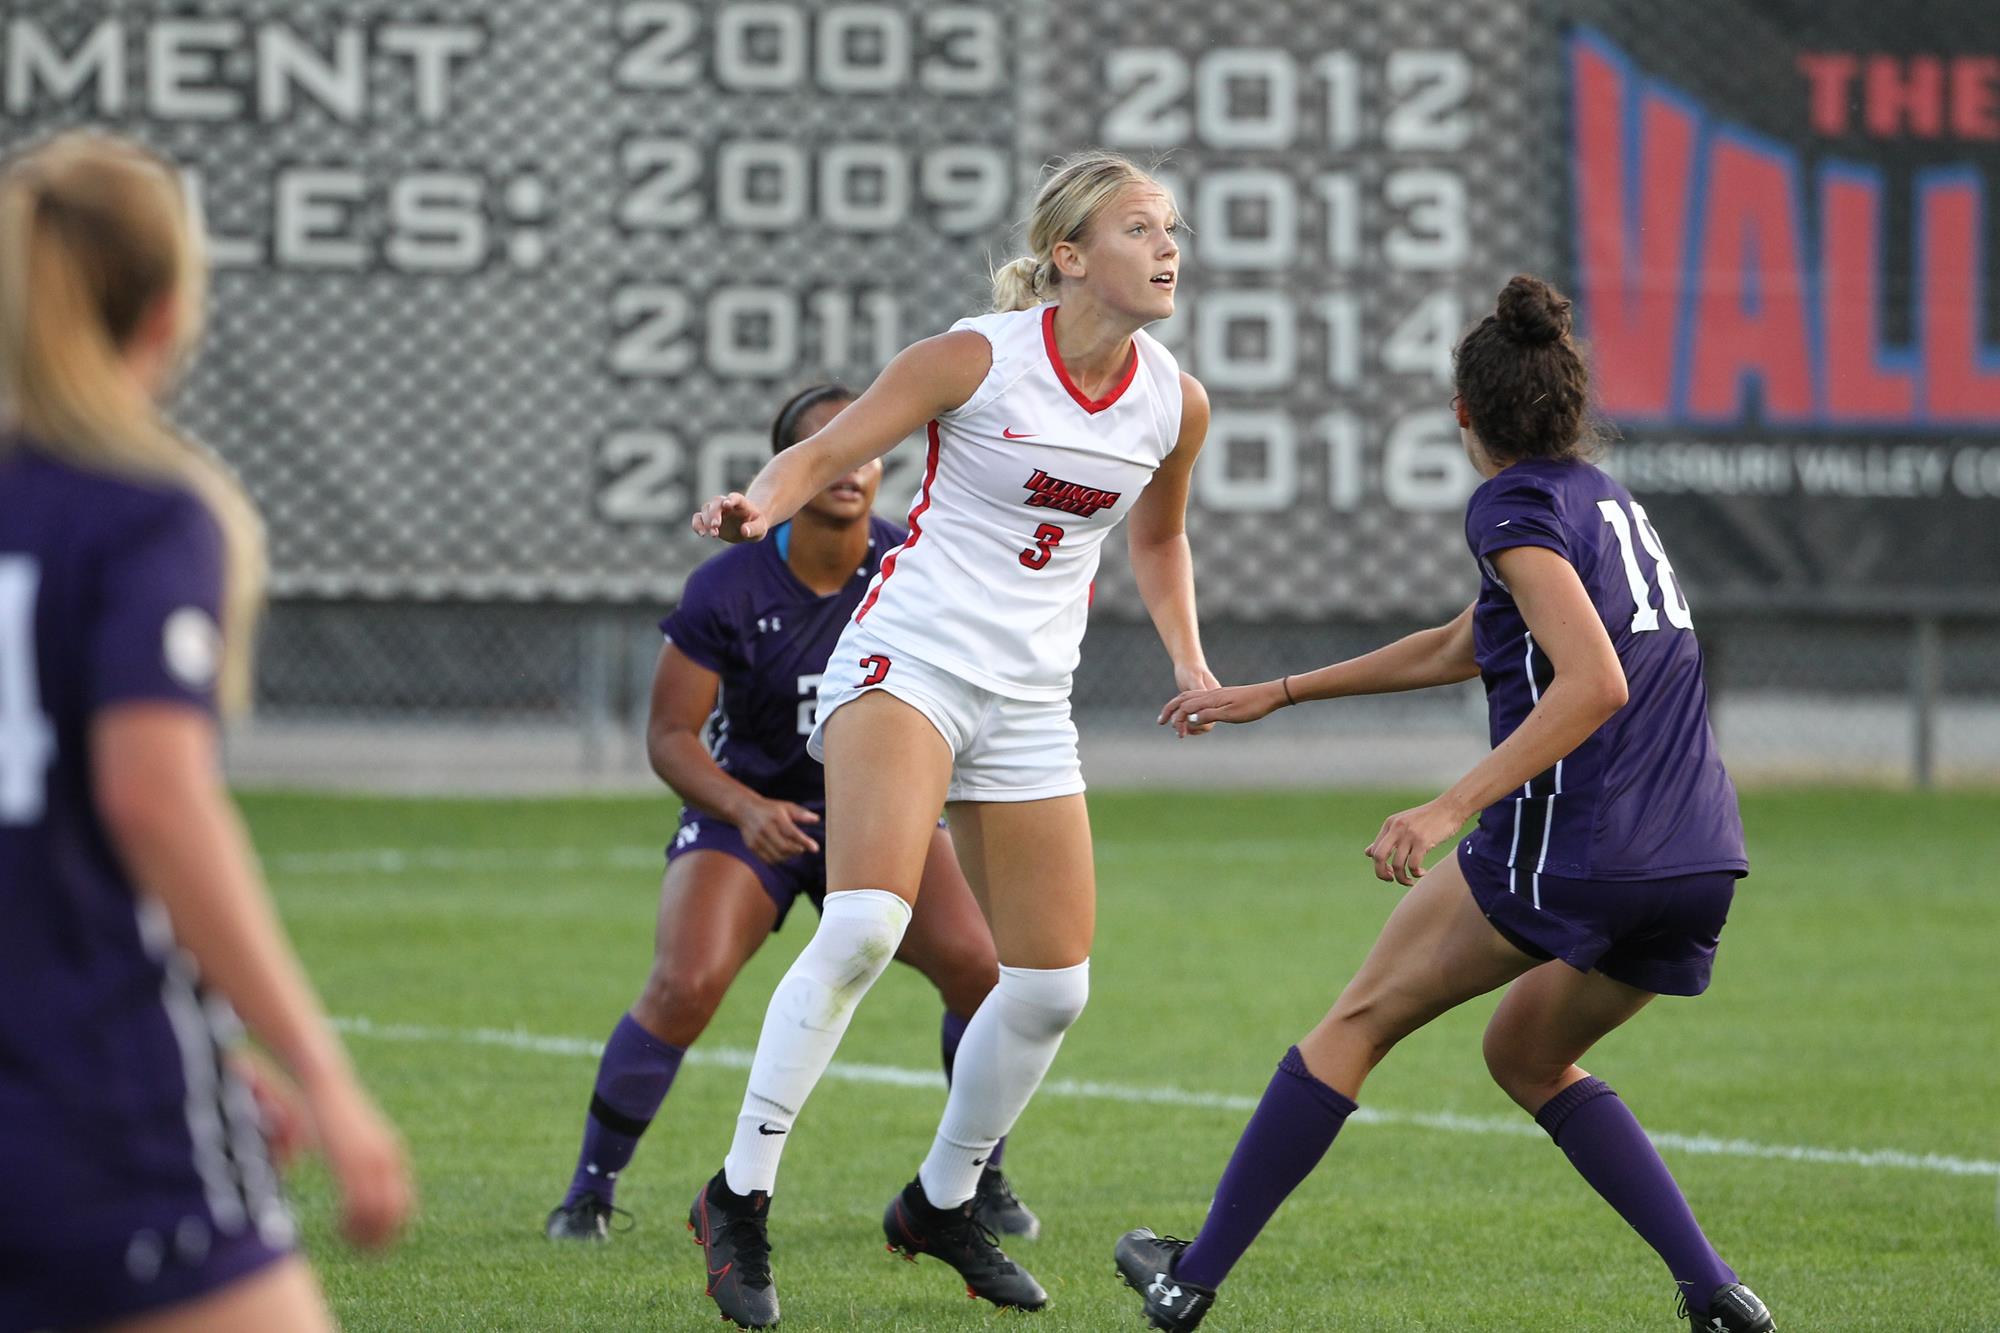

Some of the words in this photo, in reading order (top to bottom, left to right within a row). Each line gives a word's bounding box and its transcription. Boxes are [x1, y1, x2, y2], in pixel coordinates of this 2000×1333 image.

[6, 20, 484, 119] MENT
[617, 4, 1002, 92] 2003
[1102, 47, 1472, 150] 2012
[1802, 55, 2000, 139] THE
[617, 139, 1008, 231] 2009
[1158, 168, 1468, 269] 013
[1568, 24, 2000, 428] VALL
[608, 286, 899, 376] 2011
[1152, 289, 1464, 390] 014
[1023, 468, 1121, 509] ILLINOIS
[1200, 411, 1470, 511] 016
[1018, 522, 1064, 571] 3
